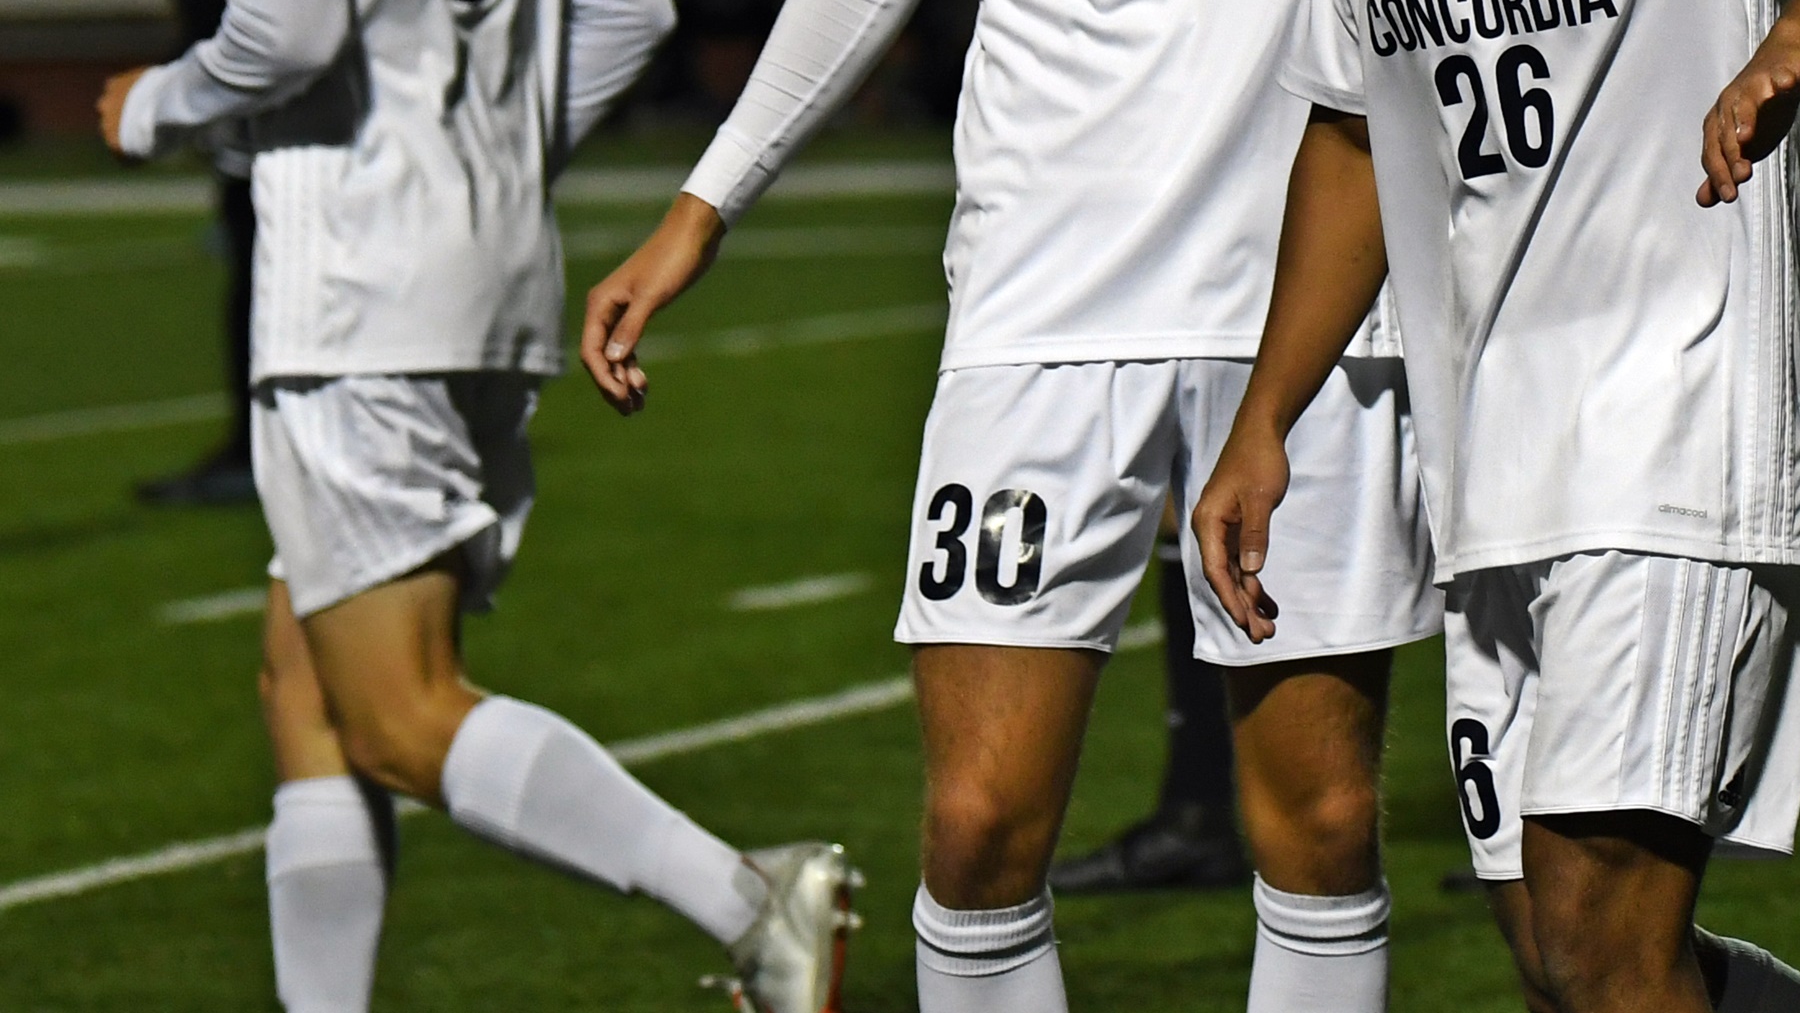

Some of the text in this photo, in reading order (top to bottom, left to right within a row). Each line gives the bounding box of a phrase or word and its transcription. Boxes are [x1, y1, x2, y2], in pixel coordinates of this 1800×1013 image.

[1434, 44, 1554, 179] 26
[919, 483, 1047, 606] 30
[1658, 503, 1708, 519] climacool
[1450, 718, 1501, 840] 6
